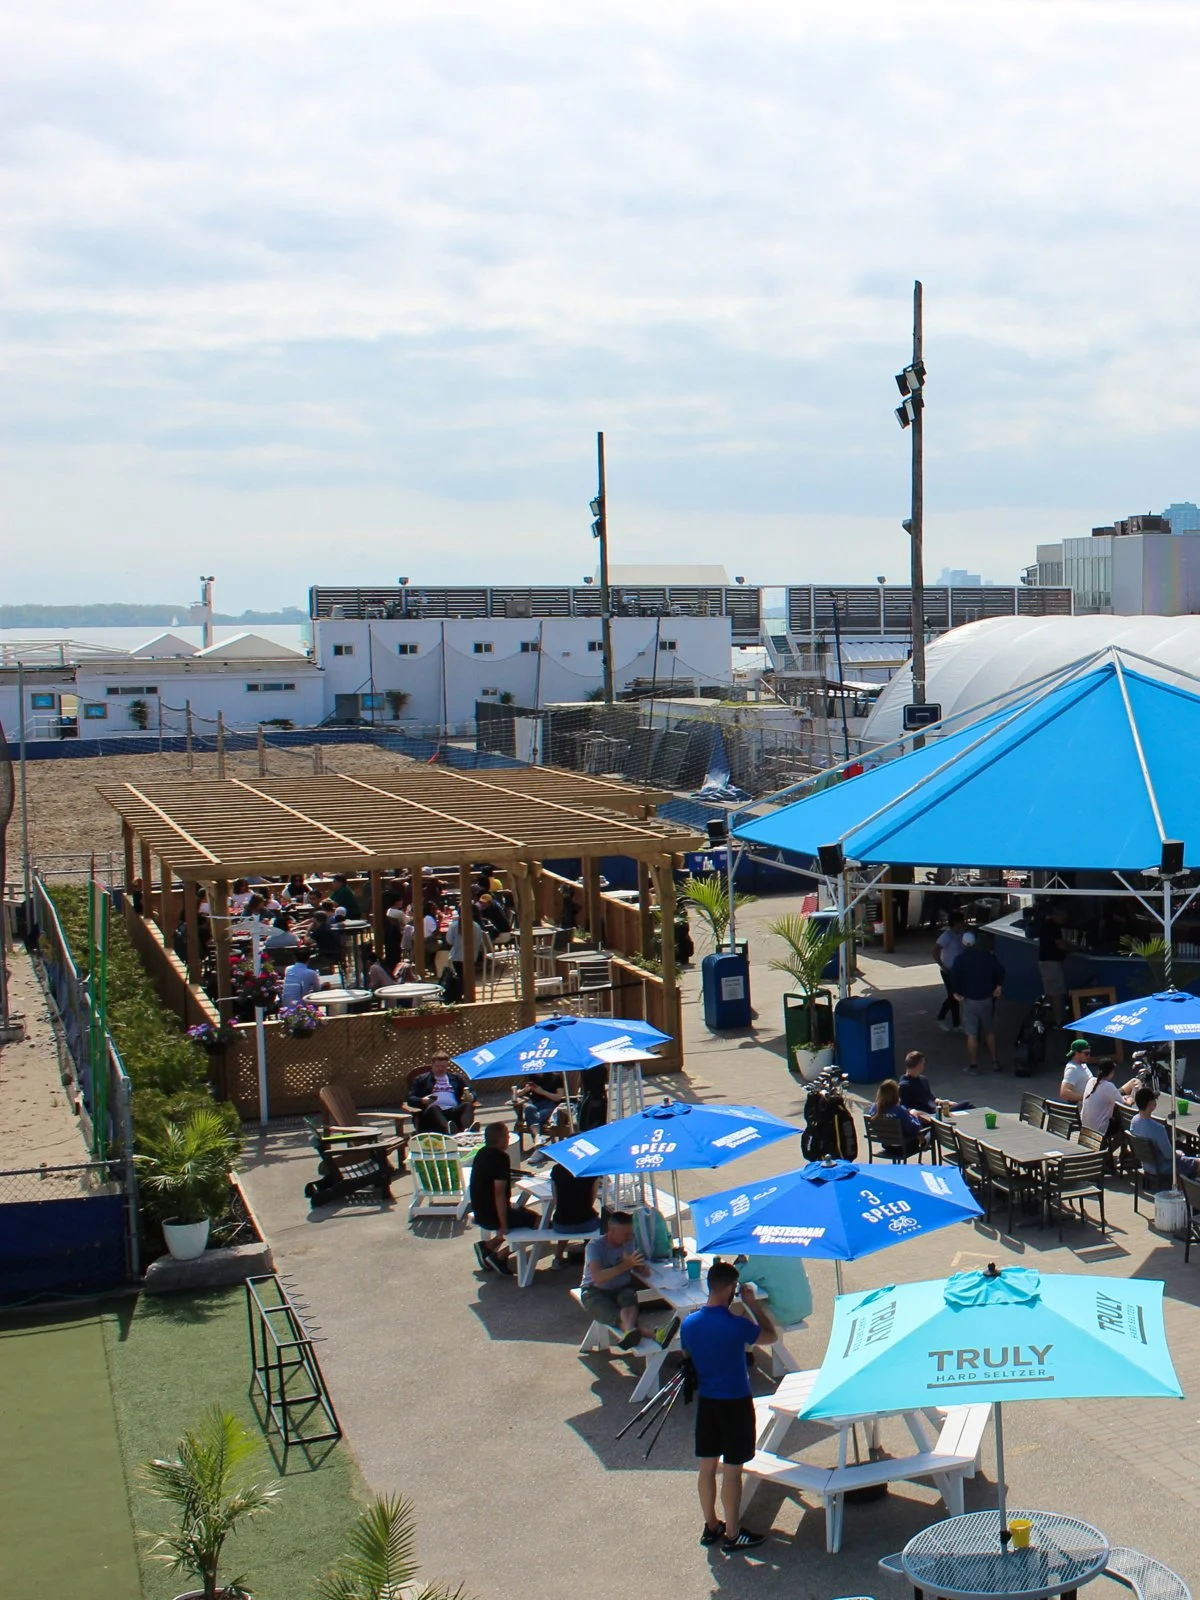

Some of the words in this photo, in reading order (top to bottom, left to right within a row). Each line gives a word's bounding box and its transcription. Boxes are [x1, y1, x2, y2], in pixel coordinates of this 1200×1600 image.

[538, 1037, 550, 1049] 3
[519, 1048, 559, 1061] SPEED
[651, 1129, 664, 1142] 3
[630, 1142, 677, 1155] SPEED
[860, 1189, 881, 1205] 3
[861, 1200, 912, 1223] SPEED
[752, 1225, 827, 1238] AMSTERDAM
[1096, 1291, 1125, 1334] TRULY
[864, 1300, 897, 1346] TRULY
[928, 1344, 1054, 1372] TRULY
[936, 1372, 977, 1382] HARD
[983, 1369, 1046, 1379] SELTZER
